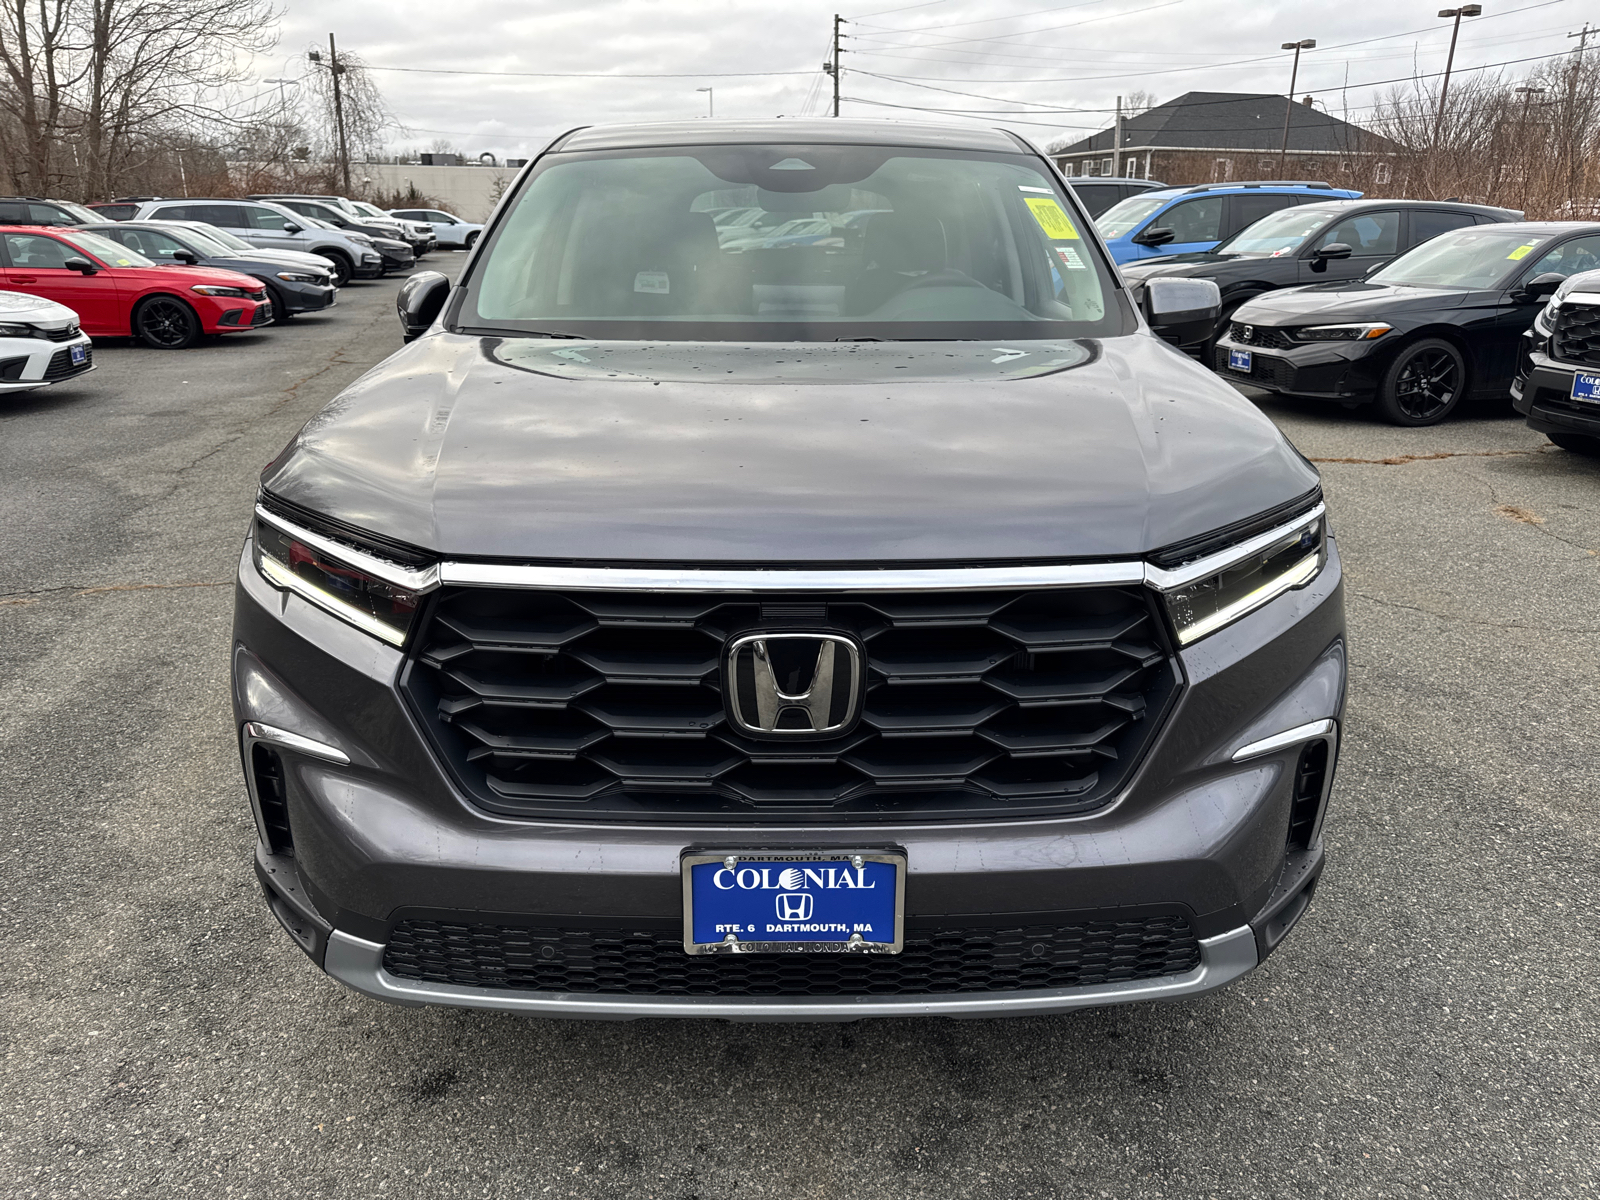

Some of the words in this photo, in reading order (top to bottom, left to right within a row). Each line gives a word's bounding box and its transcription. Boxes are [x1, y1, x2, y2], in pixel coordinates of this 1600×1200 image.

[713, 868, 876, 890] COLONIAL
[715, 924, 744, 933] RTE.
[747, 924, 755, 932] 6
[766, 923, 850, 934] DARTMOUTH,
[853, 923, 873, 932] MA
